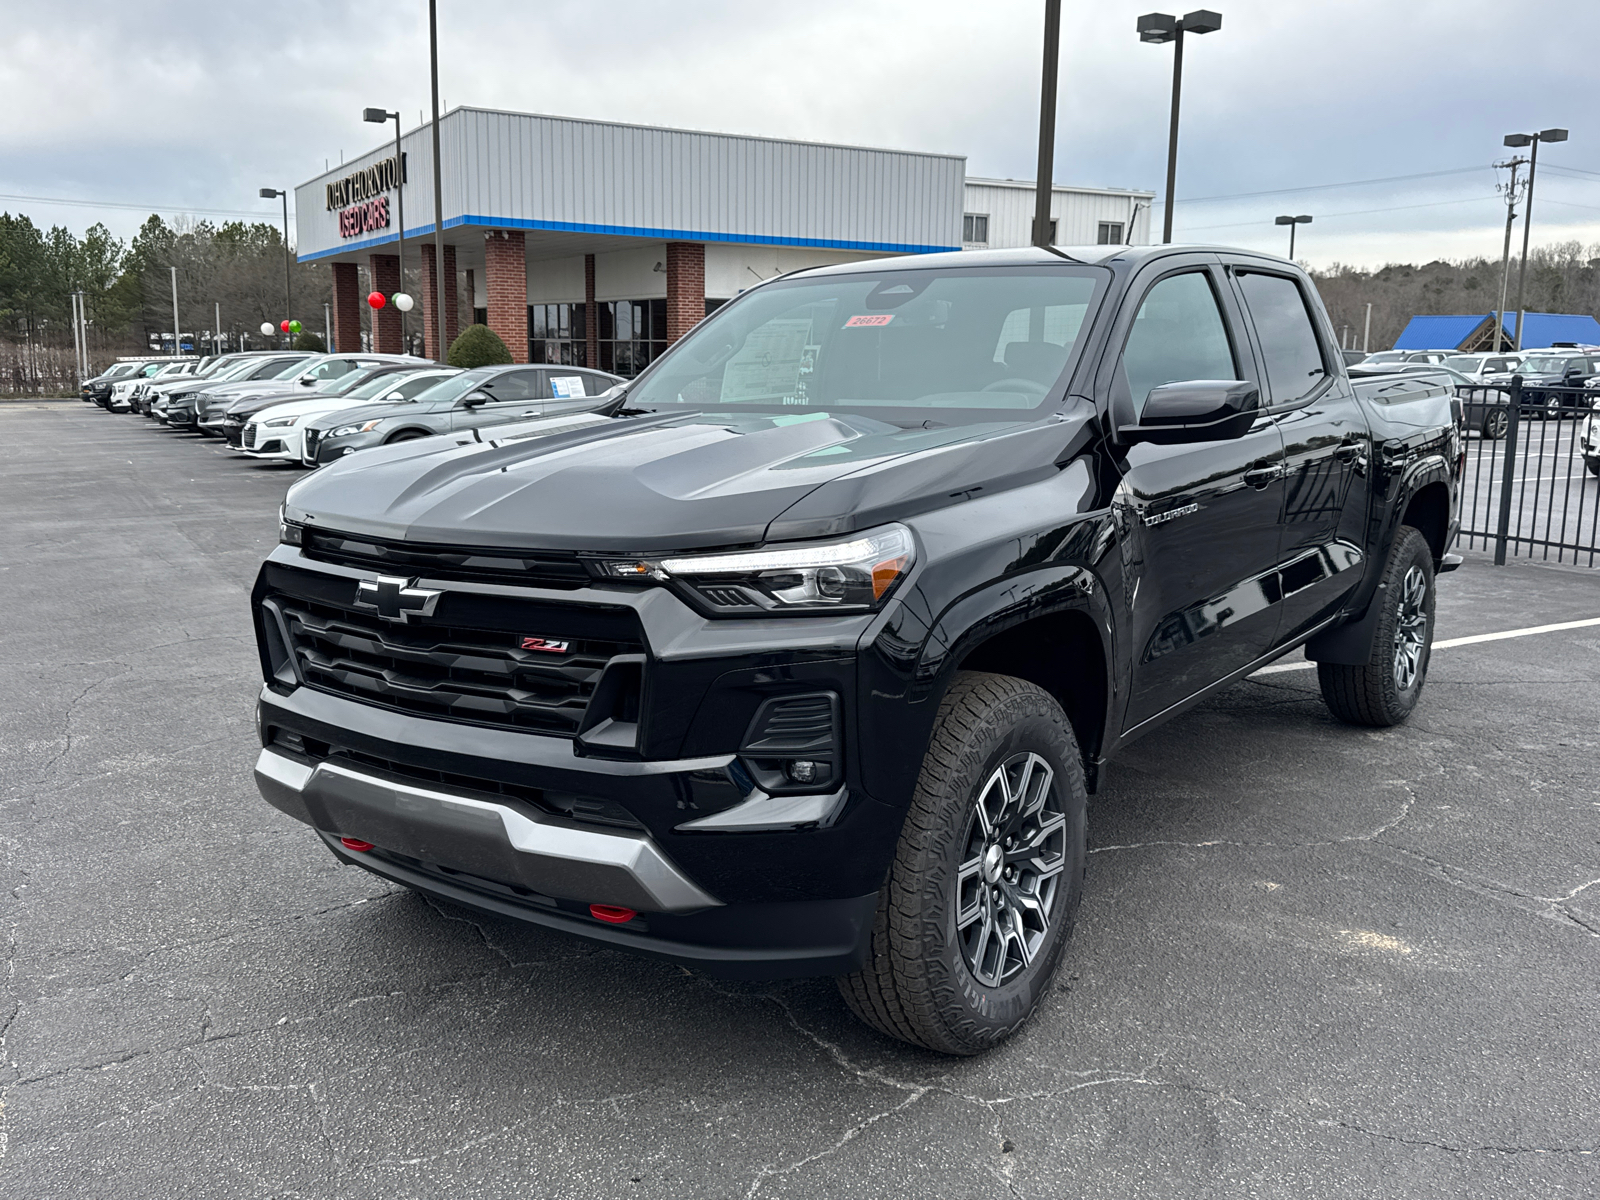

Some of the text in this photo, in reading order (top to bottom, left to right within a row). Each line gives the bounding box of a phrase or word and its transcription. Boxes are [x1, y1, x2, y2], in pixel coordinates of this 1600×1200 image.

[325, 179, 349, 211] JOHN
[338, 196, 390, 238] USED CARS
[852, 316, 887, 325] 26672
[1144, 502, 1199, 527] COLORADO
[521, 637, 569, 653] Z71
[952, 953, 1026, 1019] WRANGLER
